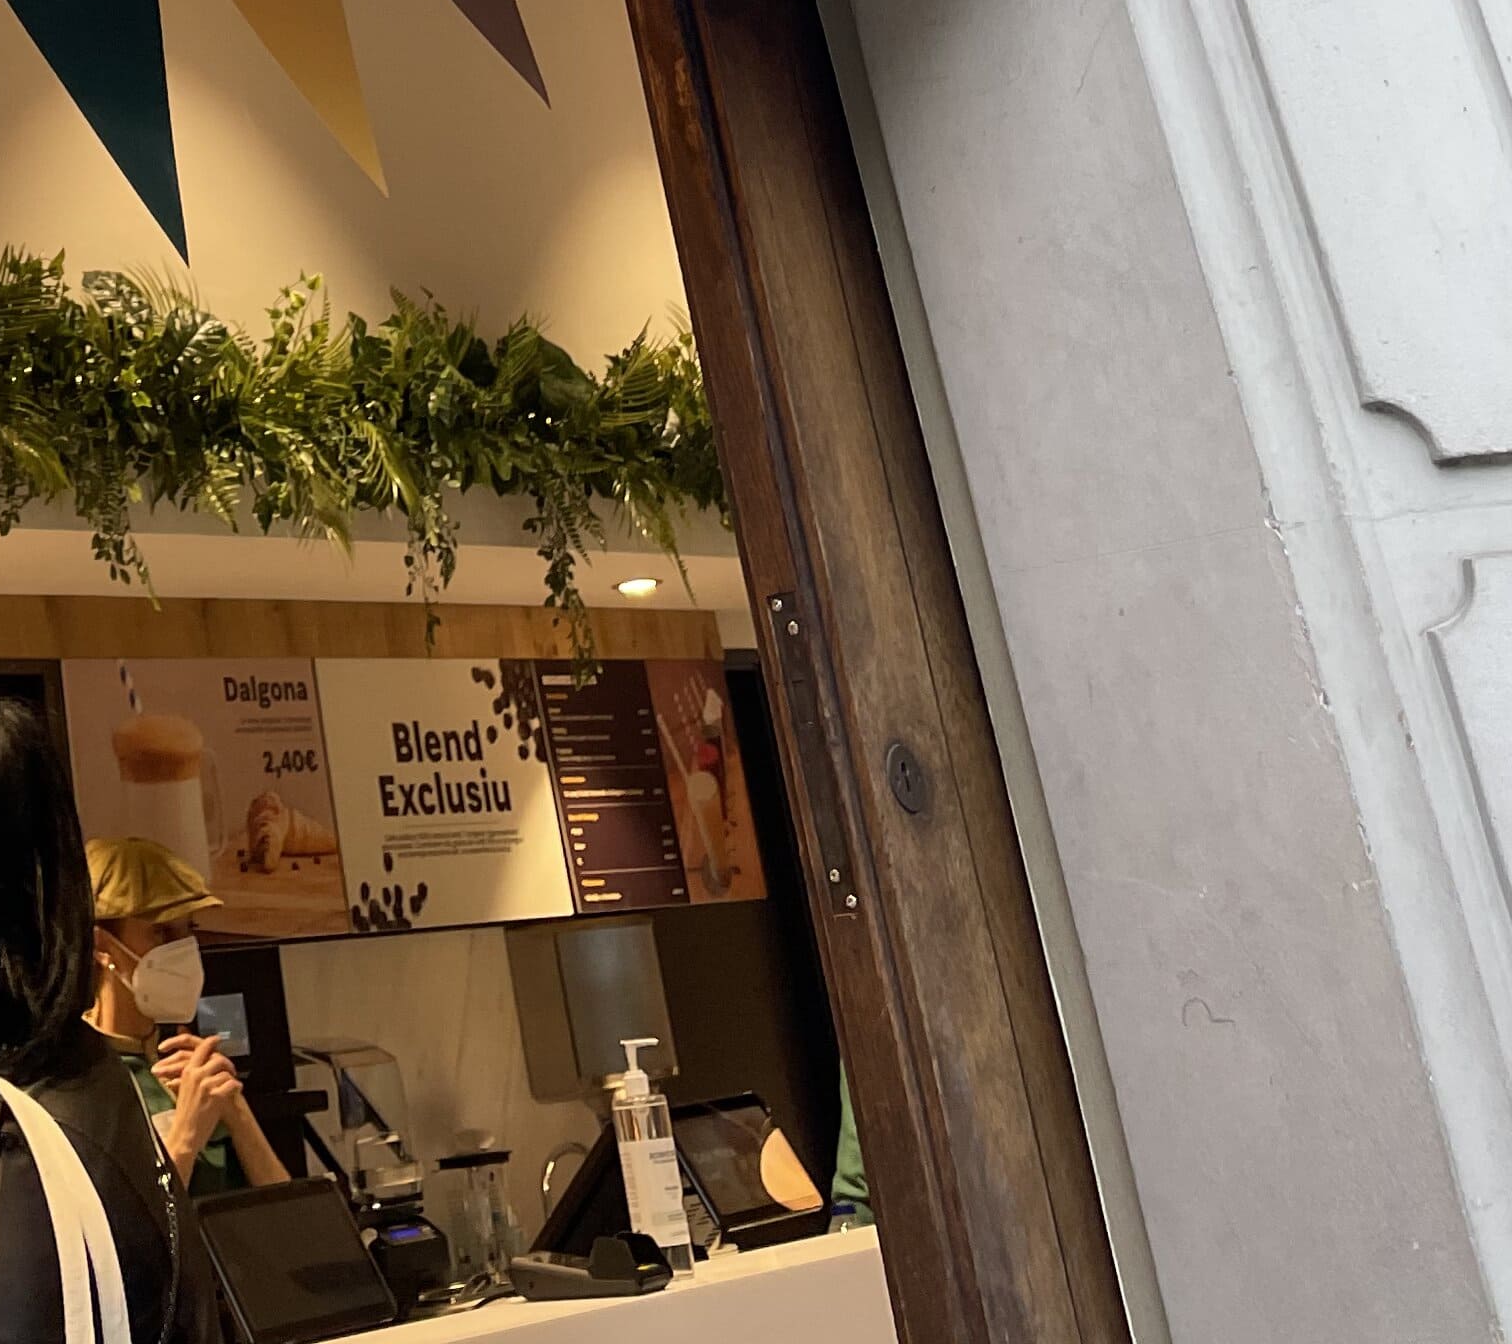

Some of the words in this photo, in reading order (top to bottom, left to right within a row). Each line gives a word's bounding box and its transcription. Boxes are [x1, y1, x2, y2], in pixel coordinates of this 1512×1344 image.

[223, 675, 308, 709] Dalgona
[392, 719, 484, 763] Blend
[262, 749, 319, 779] 2,40€
[378, 767, 513, 817] Exclusiu
